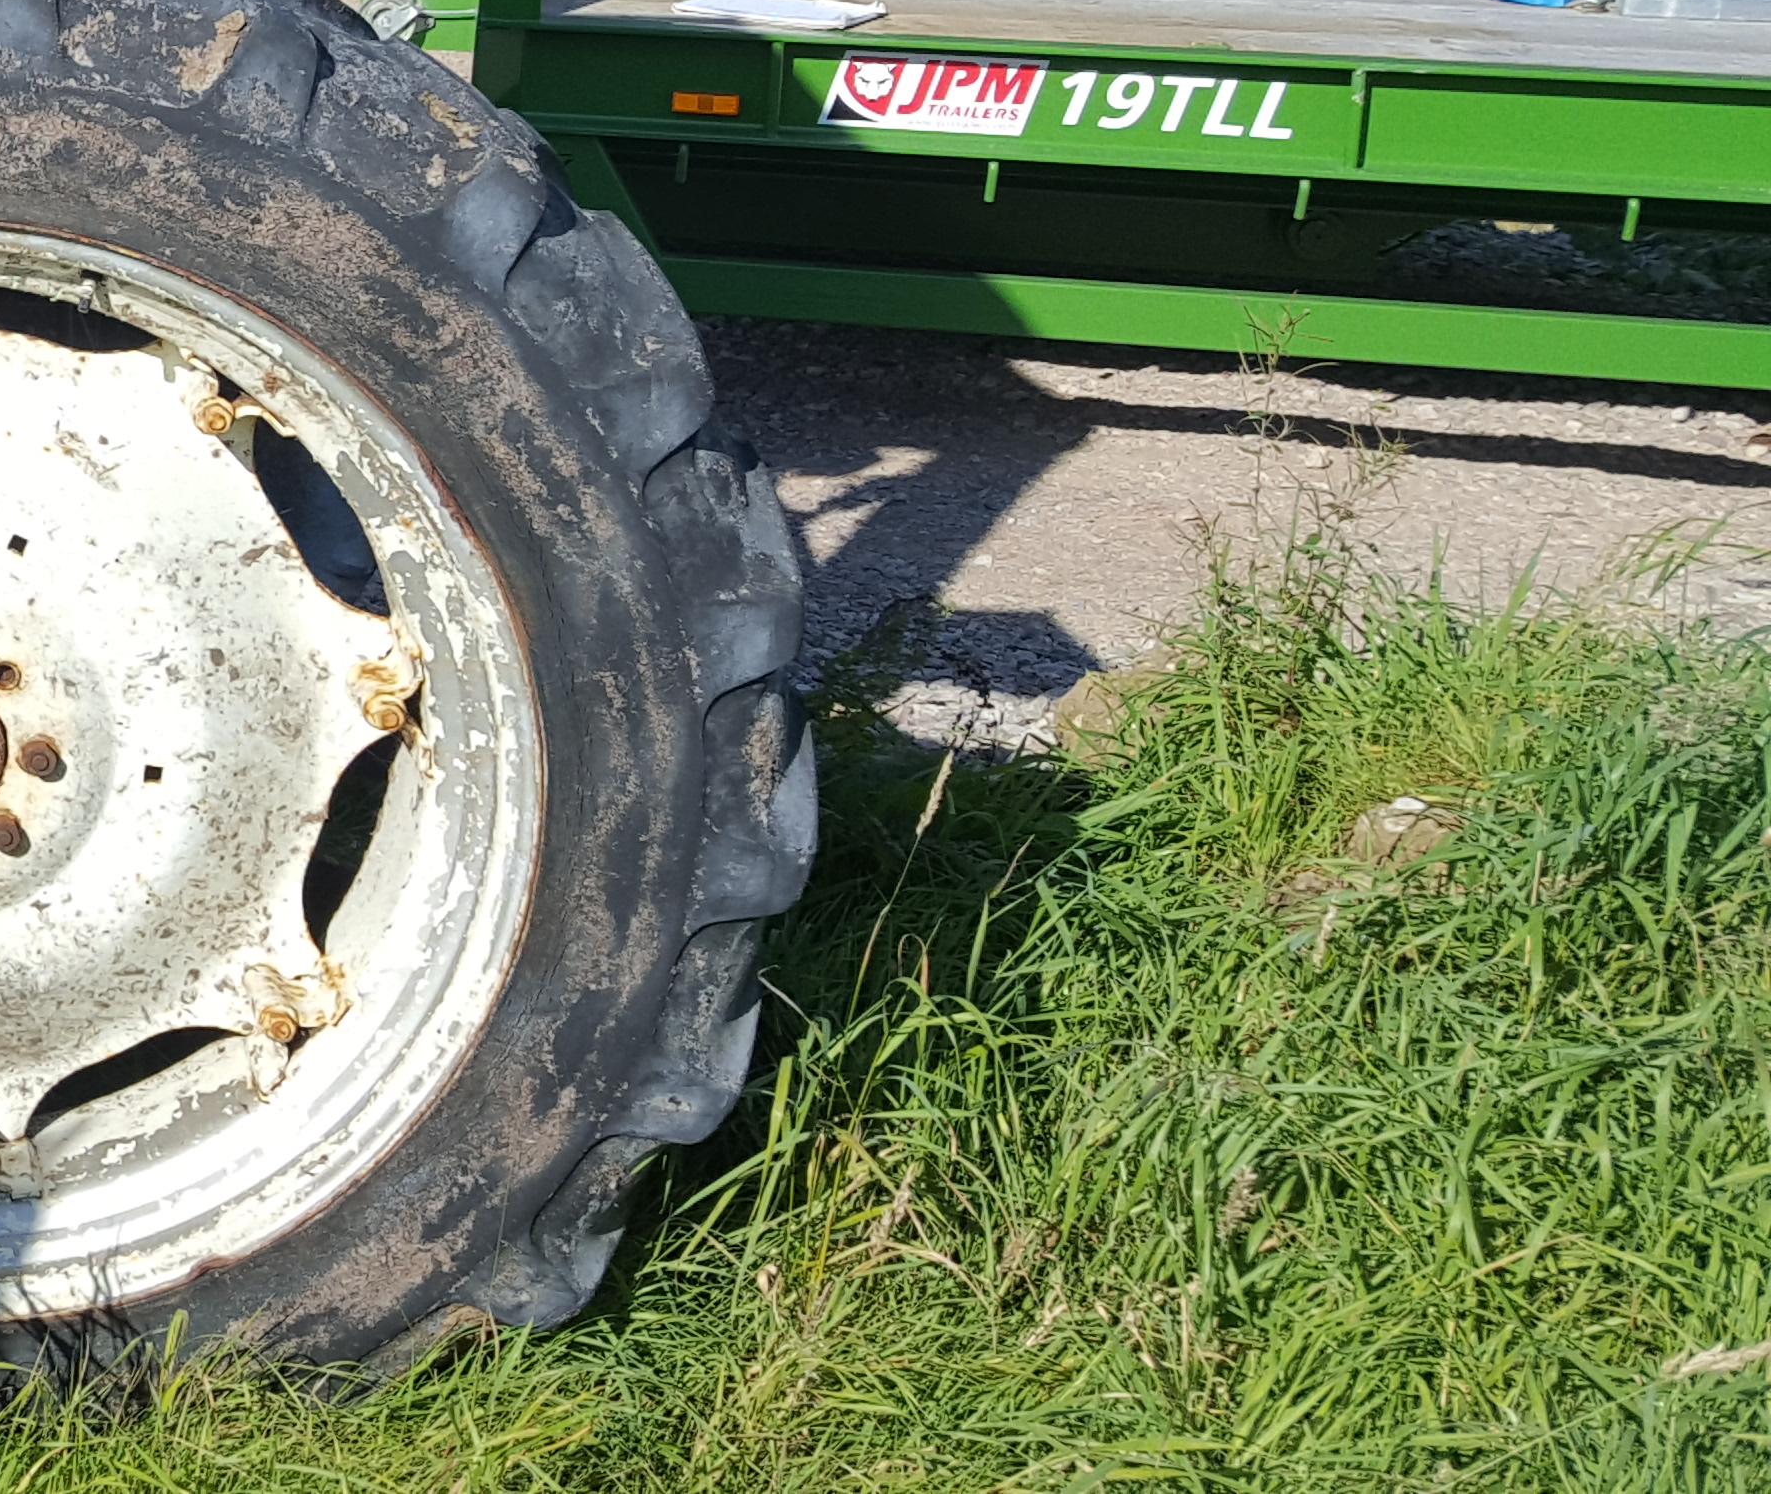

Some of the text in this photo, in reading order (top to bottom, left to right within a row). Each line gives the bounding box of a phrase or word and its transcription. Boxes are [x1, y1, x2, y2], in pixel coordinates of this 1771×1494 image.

[896, 59, 1293, 140] JPM 19TLL
[928, 104, 1021, 121] TRAILERS
